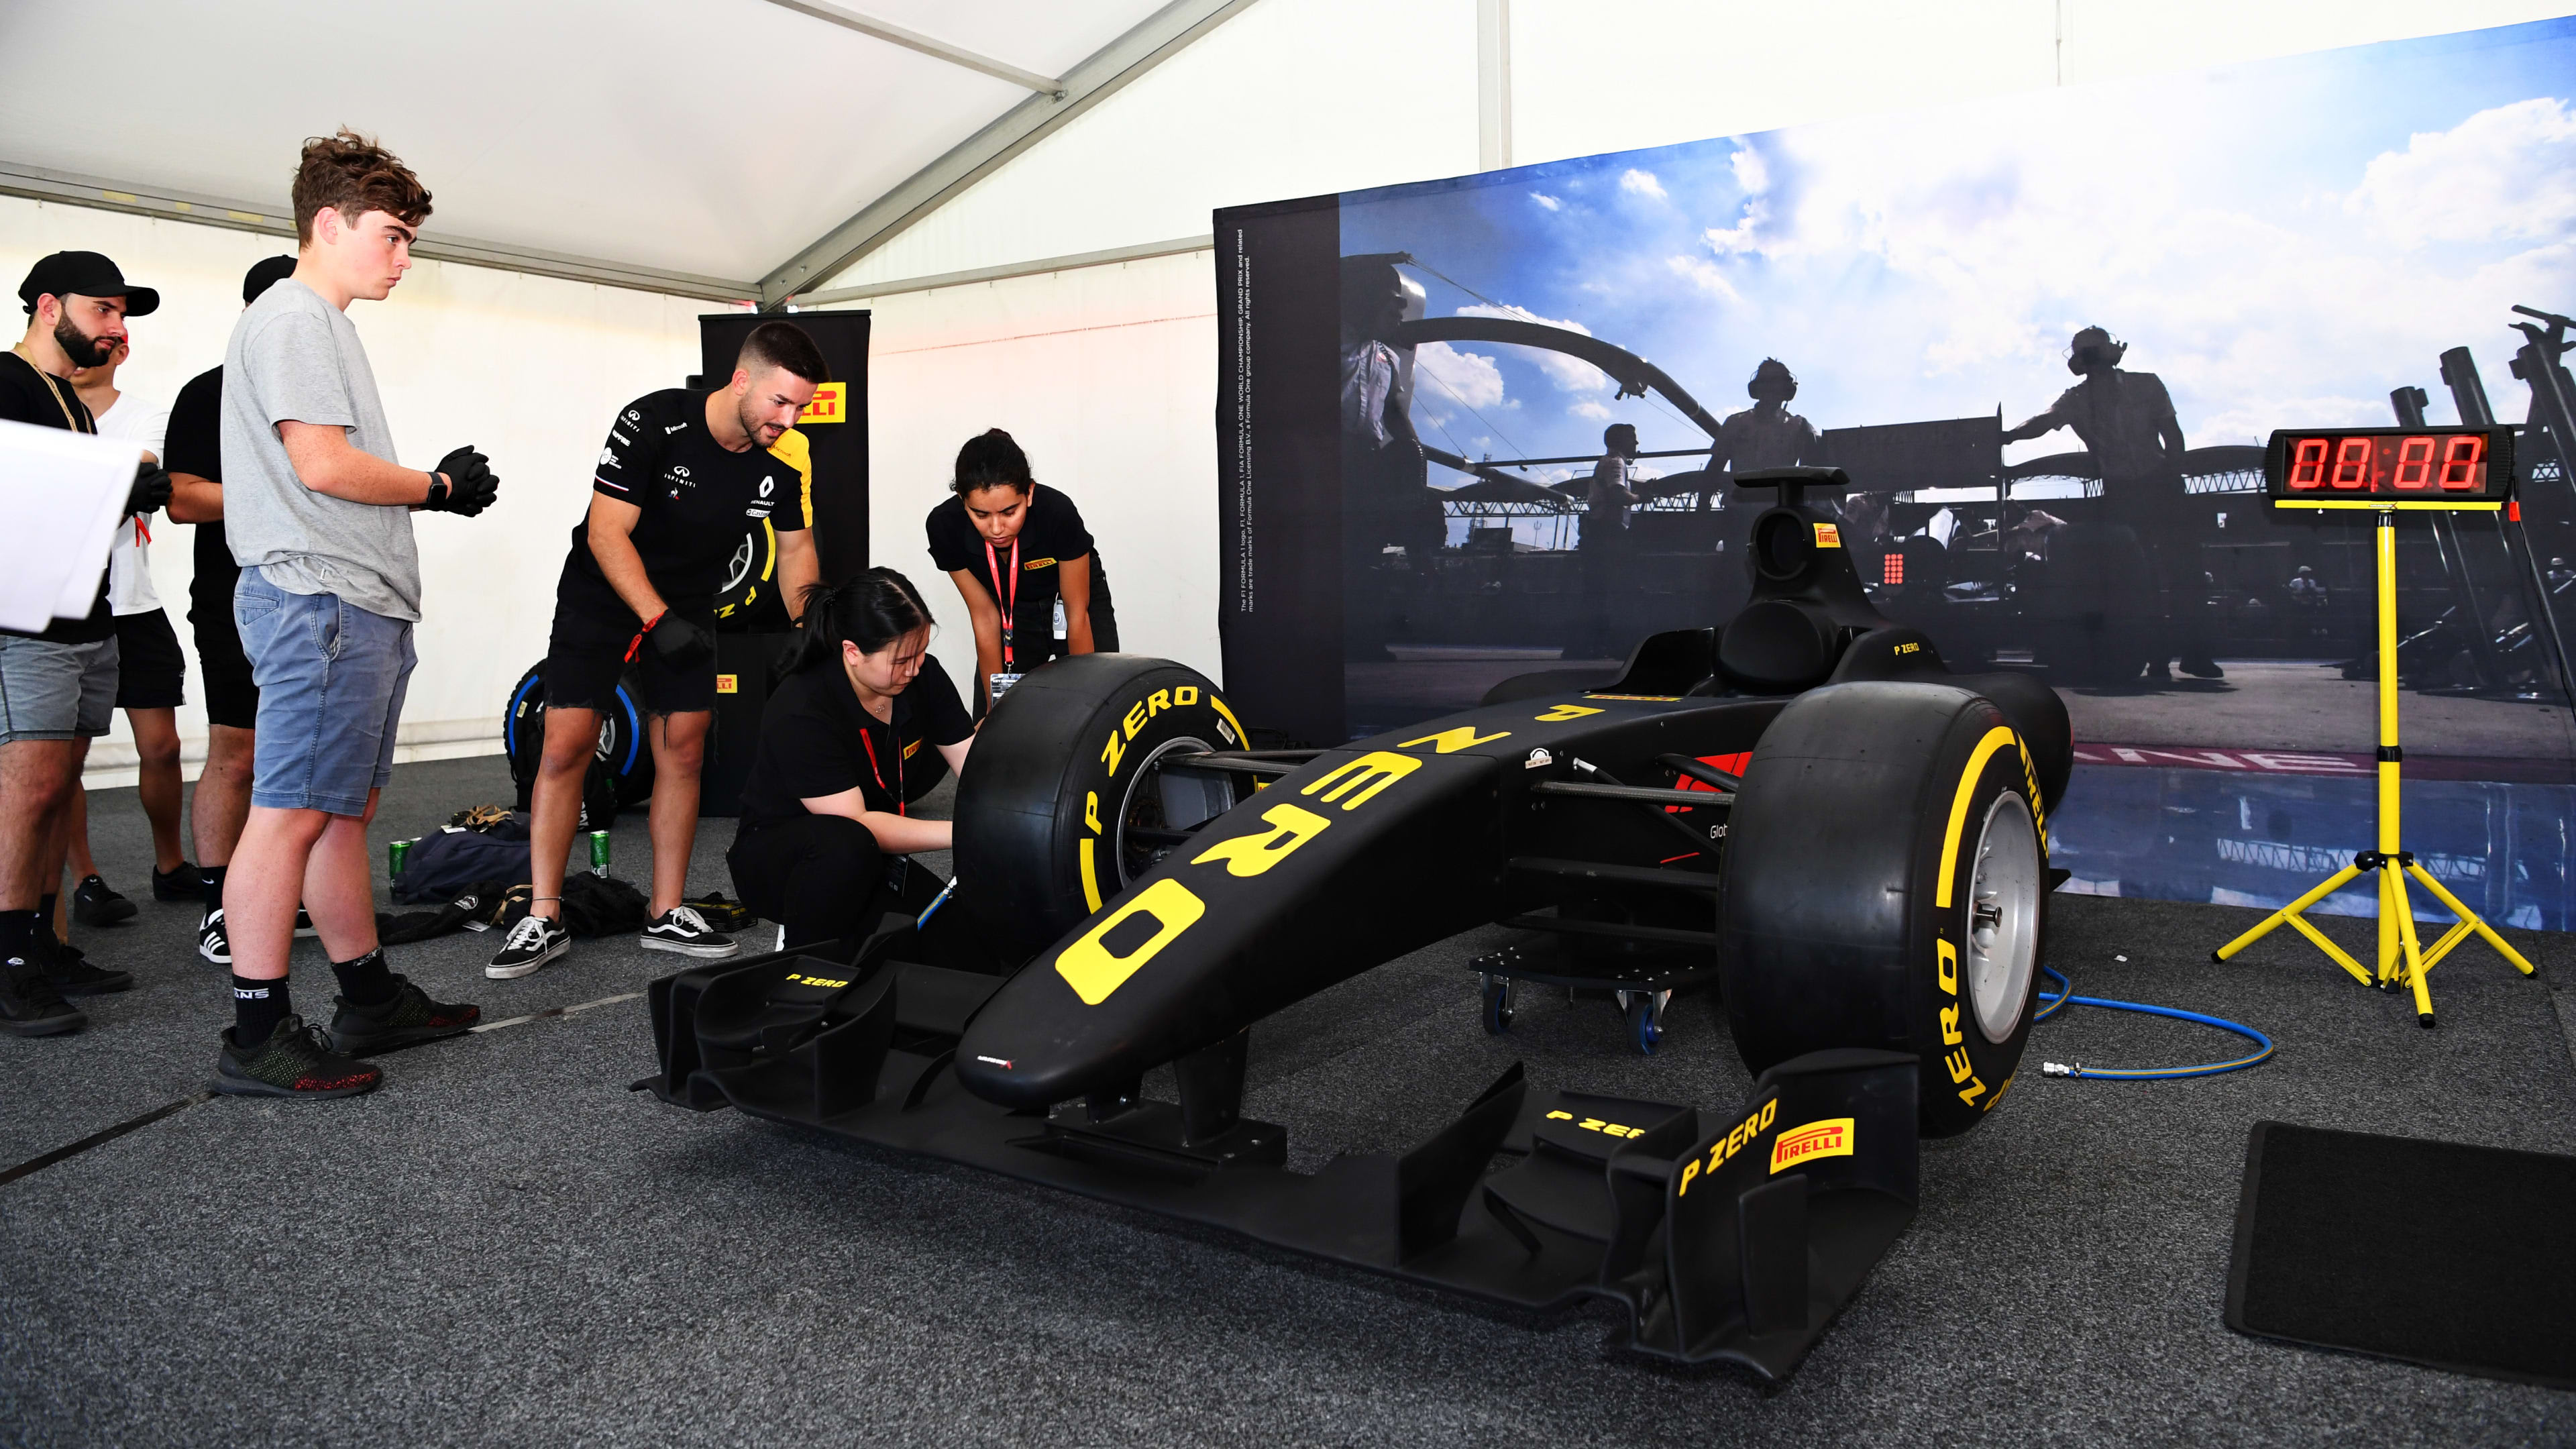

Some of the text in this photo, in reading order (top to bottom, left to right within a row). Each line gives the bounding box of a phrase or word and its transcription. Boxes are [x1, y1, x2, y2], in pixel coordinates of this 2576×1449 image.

[664, 473, 696, 488] INFINITI
[1817, 528, 1837, 543] PIRELLI
[1894, 643, 1919, 656] P ZERO
[1534, 704, 1606, 721] P
[1085, 686, 1198, 835] P ZERO
[800, 977, 849, 987] ZERO
[234, 989, 269, 1000] ANS
[1937, 938, 1986, 1107] ZERO
[1546, 1110, 1645, 1139] P ZER
[1679, 1097, 1777, 1197] P ZERO
[1776, 1126, 1843, 1164] PIRELLI
